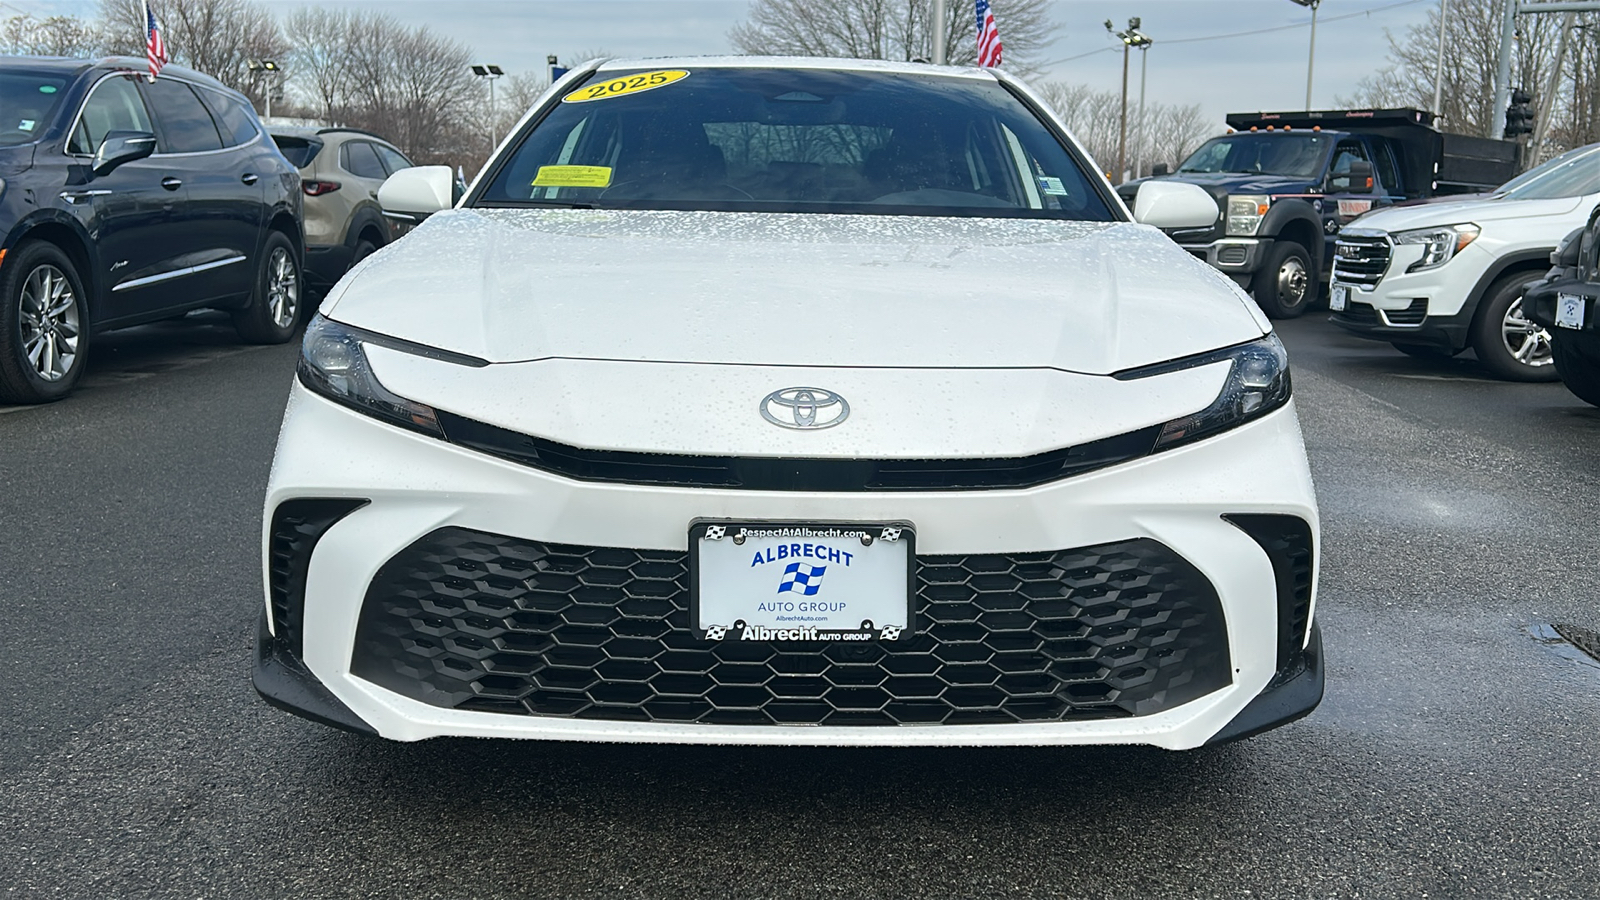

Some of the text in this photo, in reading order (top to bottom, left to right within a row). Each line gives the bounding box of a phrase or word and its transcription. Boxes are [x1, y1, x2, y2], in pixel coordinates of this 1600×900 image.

[588, 72, 667, 98] 2025
[740, 528, 867, 539] RespectAtAlbrecht.com
[751, 543, 854, 567] ALBRECHT
[757, 602, 847, 612] AUTO GROUP
[740, 625, 872, 641] Albrecht AUTO GROUP
